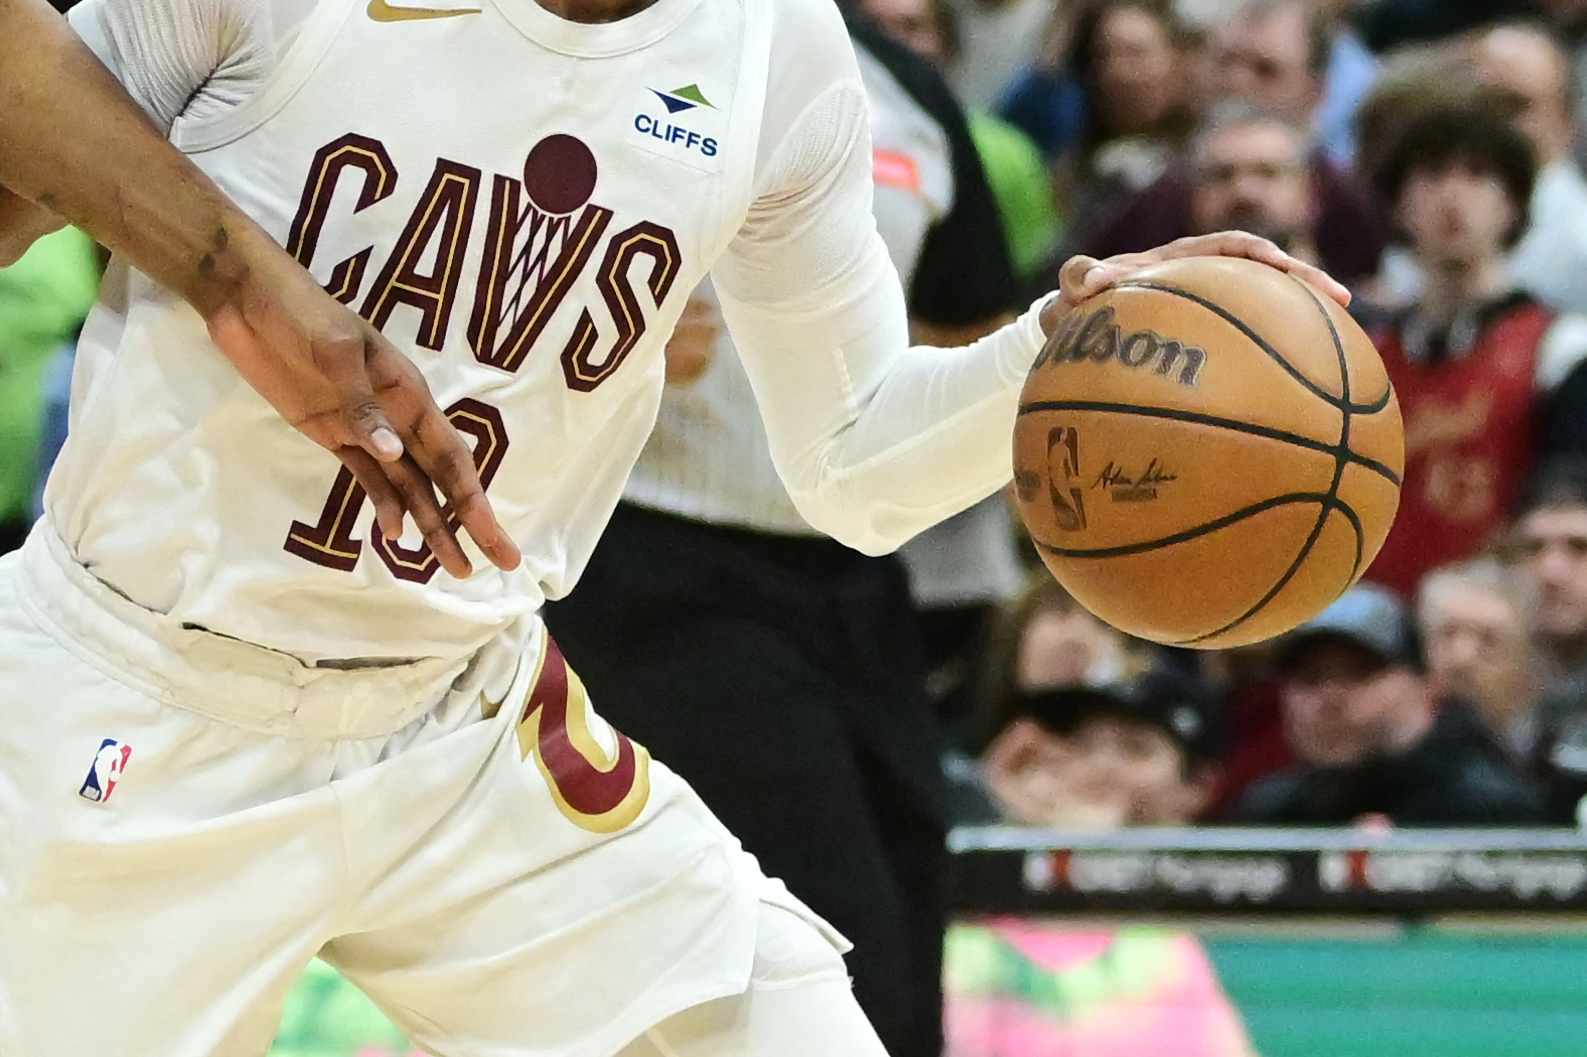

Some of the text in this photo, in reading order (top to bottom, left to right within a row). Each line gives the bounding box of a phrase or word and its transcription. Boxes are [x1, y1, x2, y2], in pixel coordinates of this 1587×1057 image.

[634, 113, 718, 157] CLIFFS
[287, 132, 682, 393] CAVS
[1032, 305, 1209, 388] ilson
